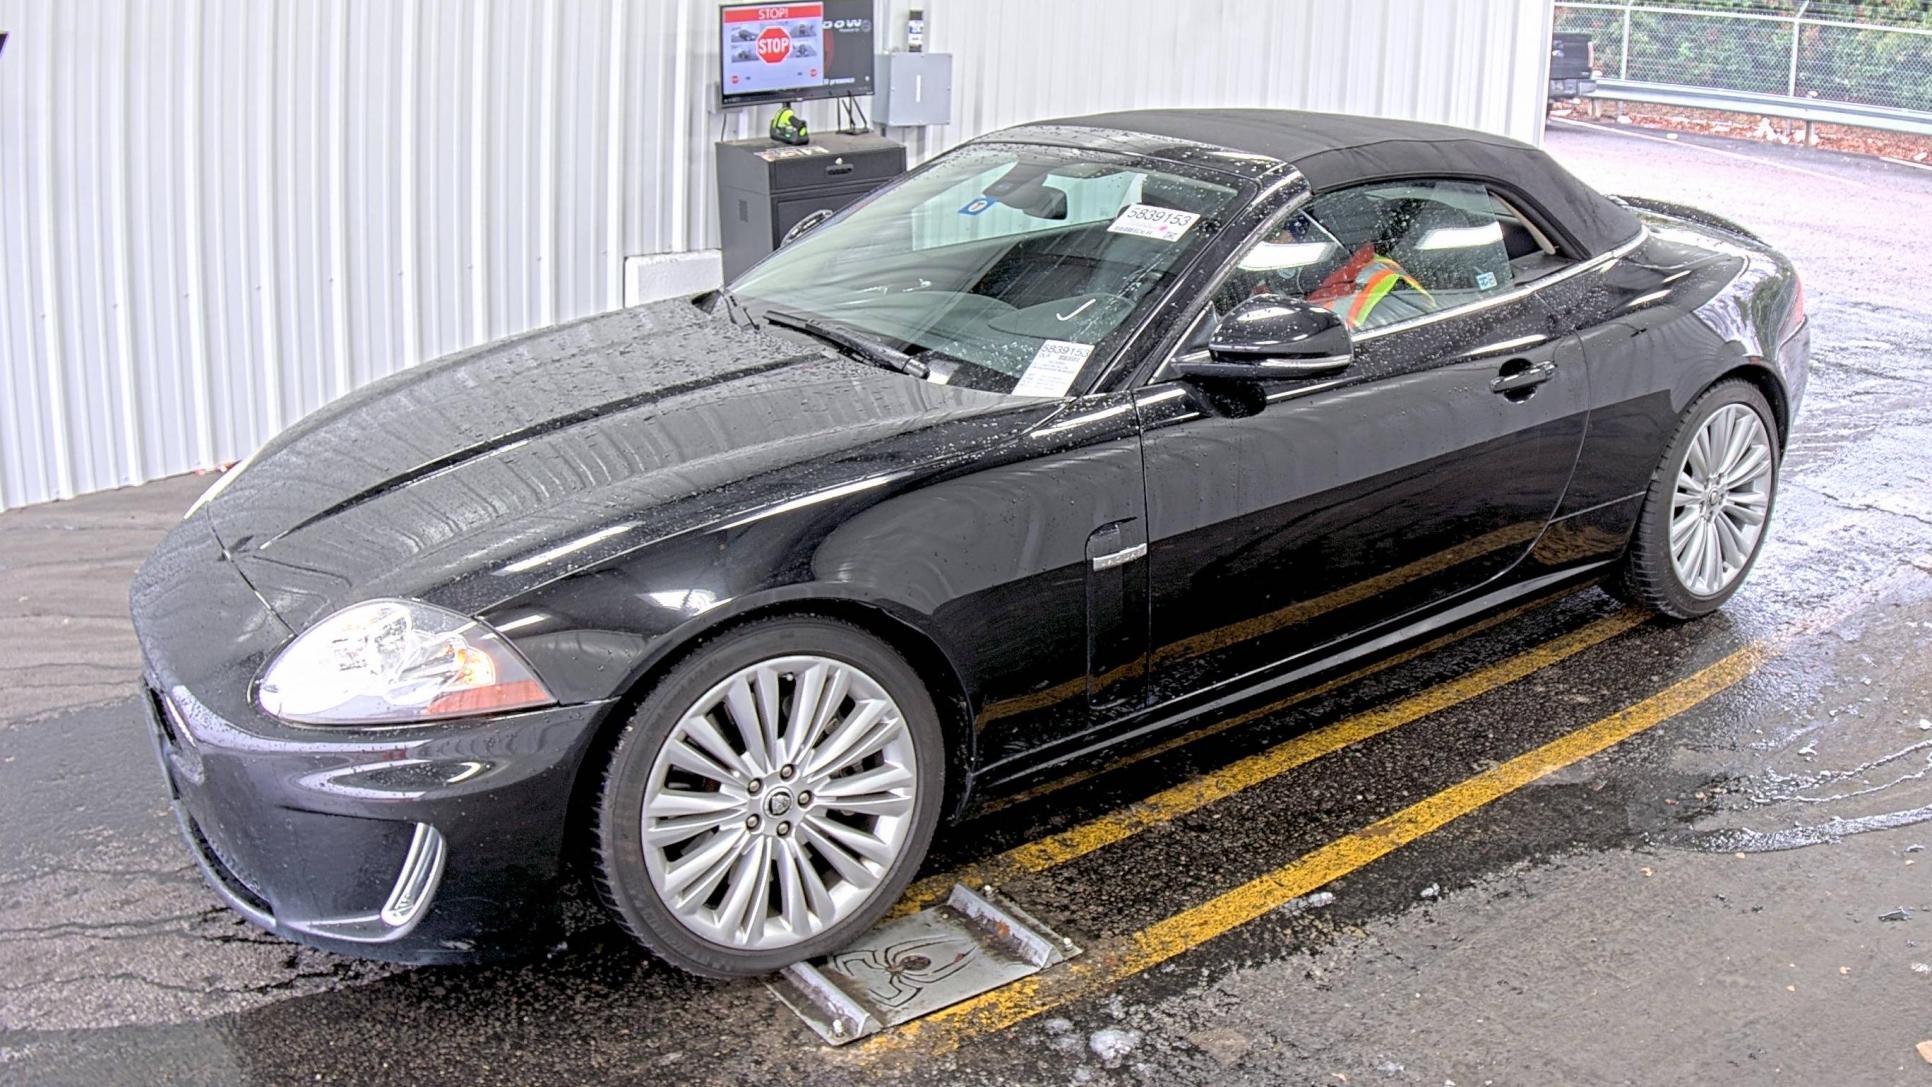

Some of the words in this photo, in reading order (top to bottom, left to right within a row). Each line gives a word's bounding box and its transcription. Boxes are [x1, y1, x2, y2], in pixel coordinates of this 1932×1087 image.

[758, 8, 789, 19] STOP!
[758, 37, 789, 54] STOP
[1127, 207, 1192, 226] 5839153
[1041, 344, 1090, 358] 5839153
